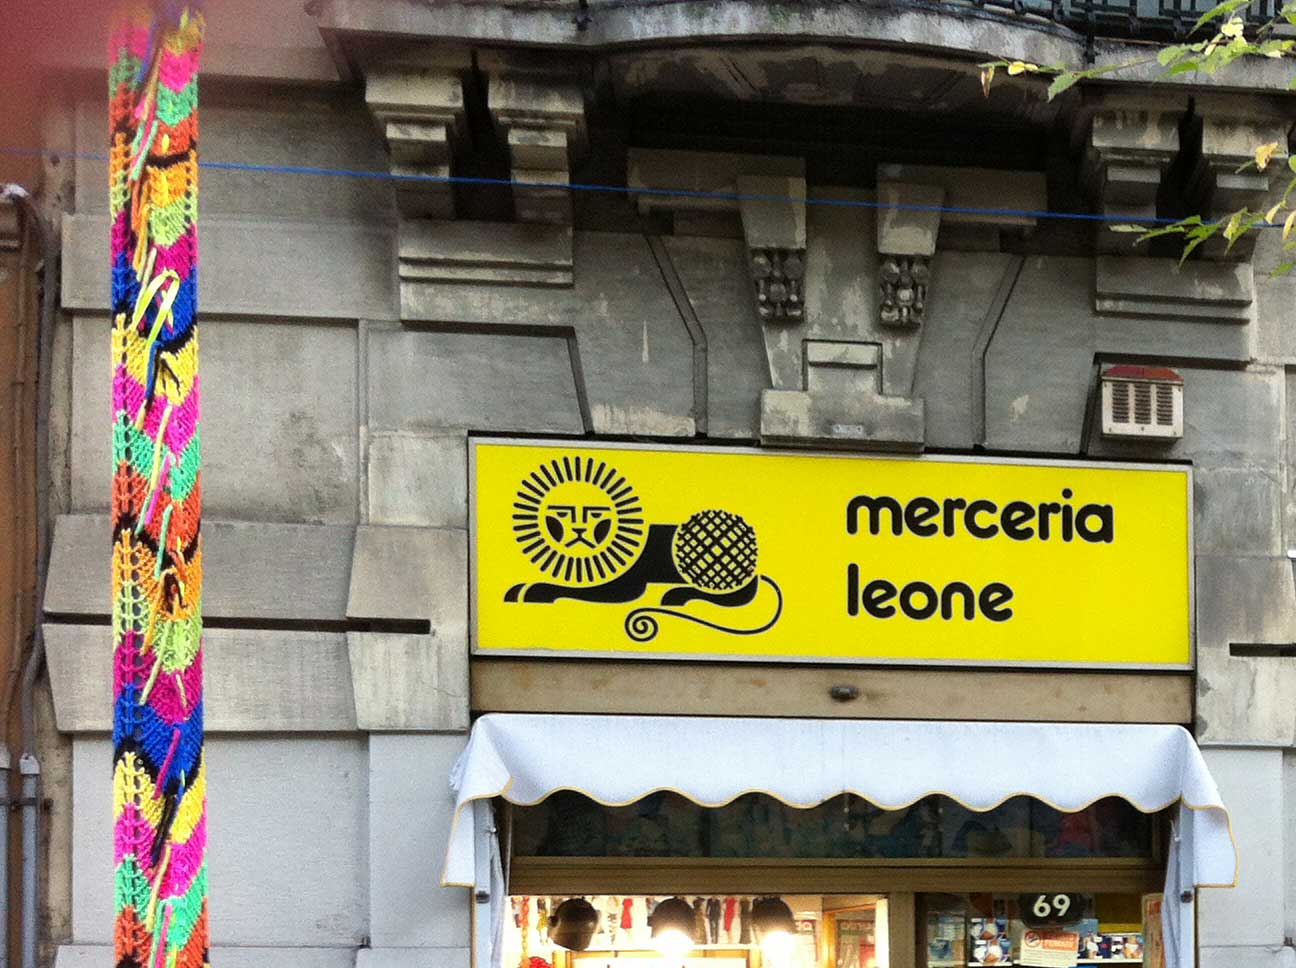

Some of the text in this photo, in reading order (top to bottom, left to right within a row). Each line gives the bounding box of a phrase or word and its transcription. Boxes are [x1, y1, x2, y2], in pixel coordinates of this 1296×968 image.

[847, 489, 1113, 543] merceria
[848, 564, 1013, 621] leone
[1033, 894, 1071, 917] 69
